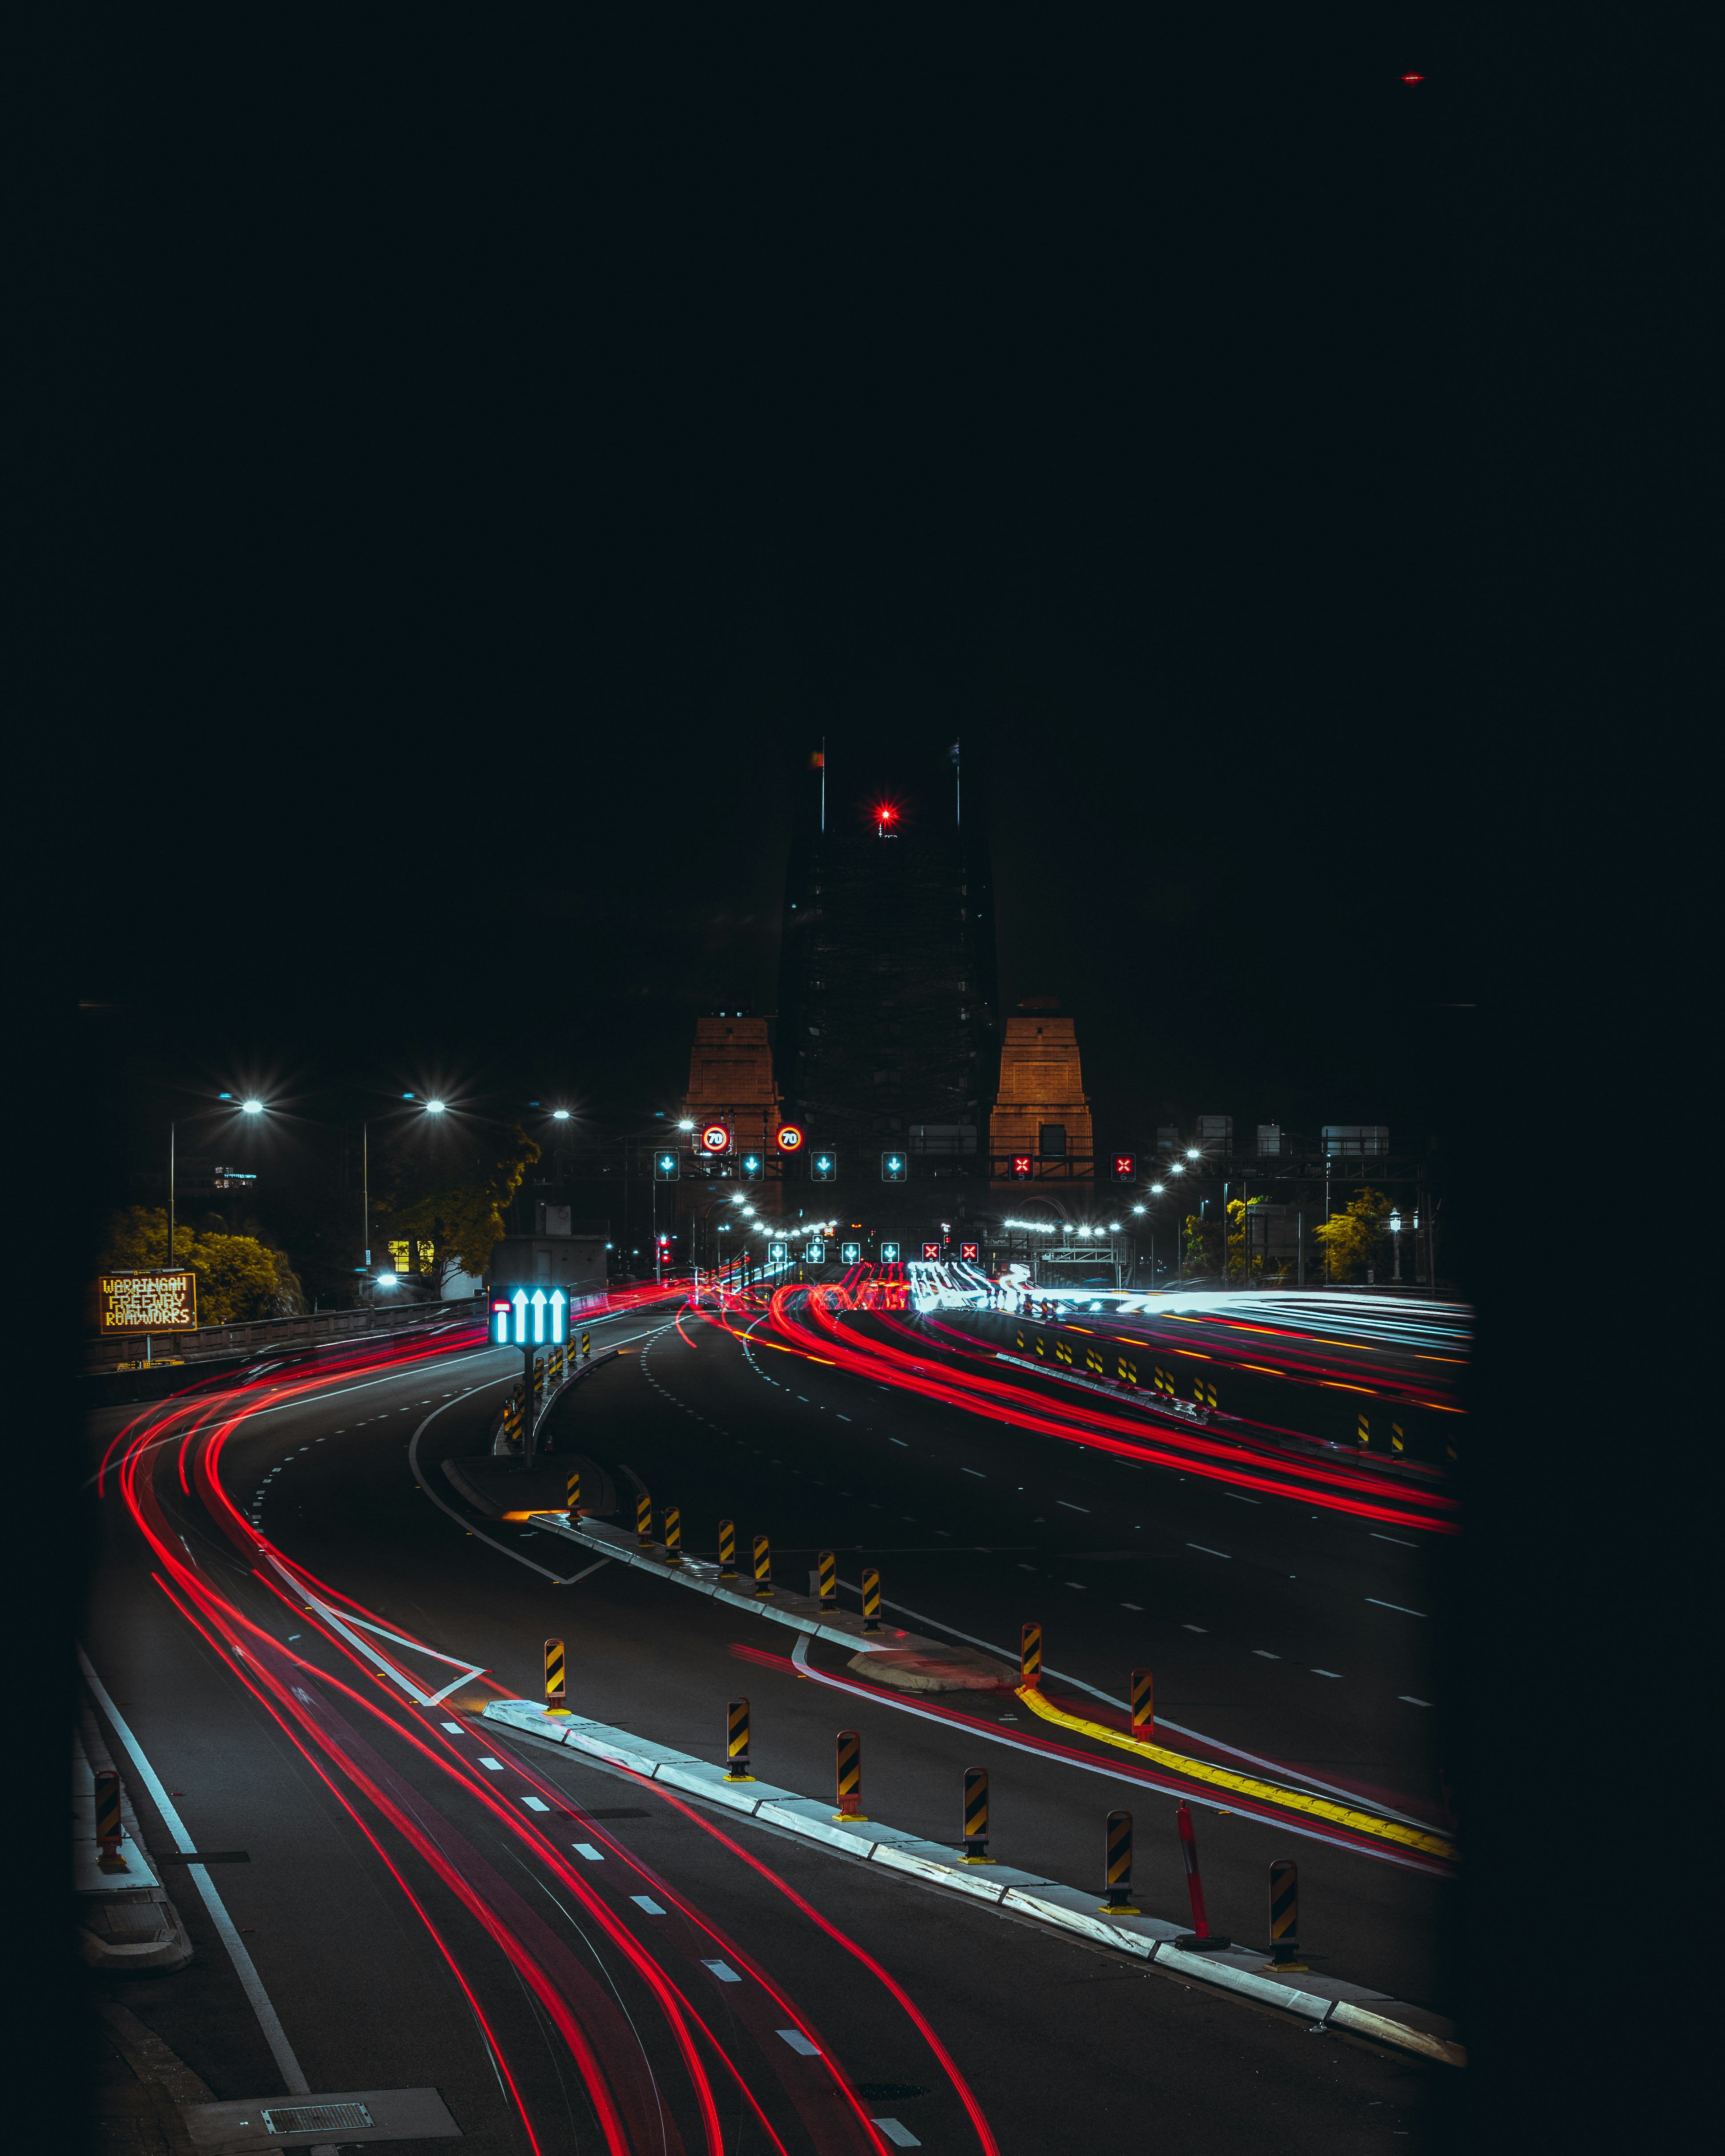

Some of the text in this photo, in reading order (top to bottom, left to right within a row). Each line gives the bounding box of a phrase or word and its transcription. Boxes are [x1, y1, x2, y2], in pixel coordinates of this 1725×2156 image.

[708, 1133, 723, 1144] 70
[782, 1133, 797, 1144] 70
[665, 1171, 669, 1179] 1
[1018, 1172, 1024, 1180] 5
[103, 1277, 186, 1293] WARRINGAH
[109, 1293, 185, 1309] FREEWAY
[106, 1309, 189, 1326] ROADWORKS
